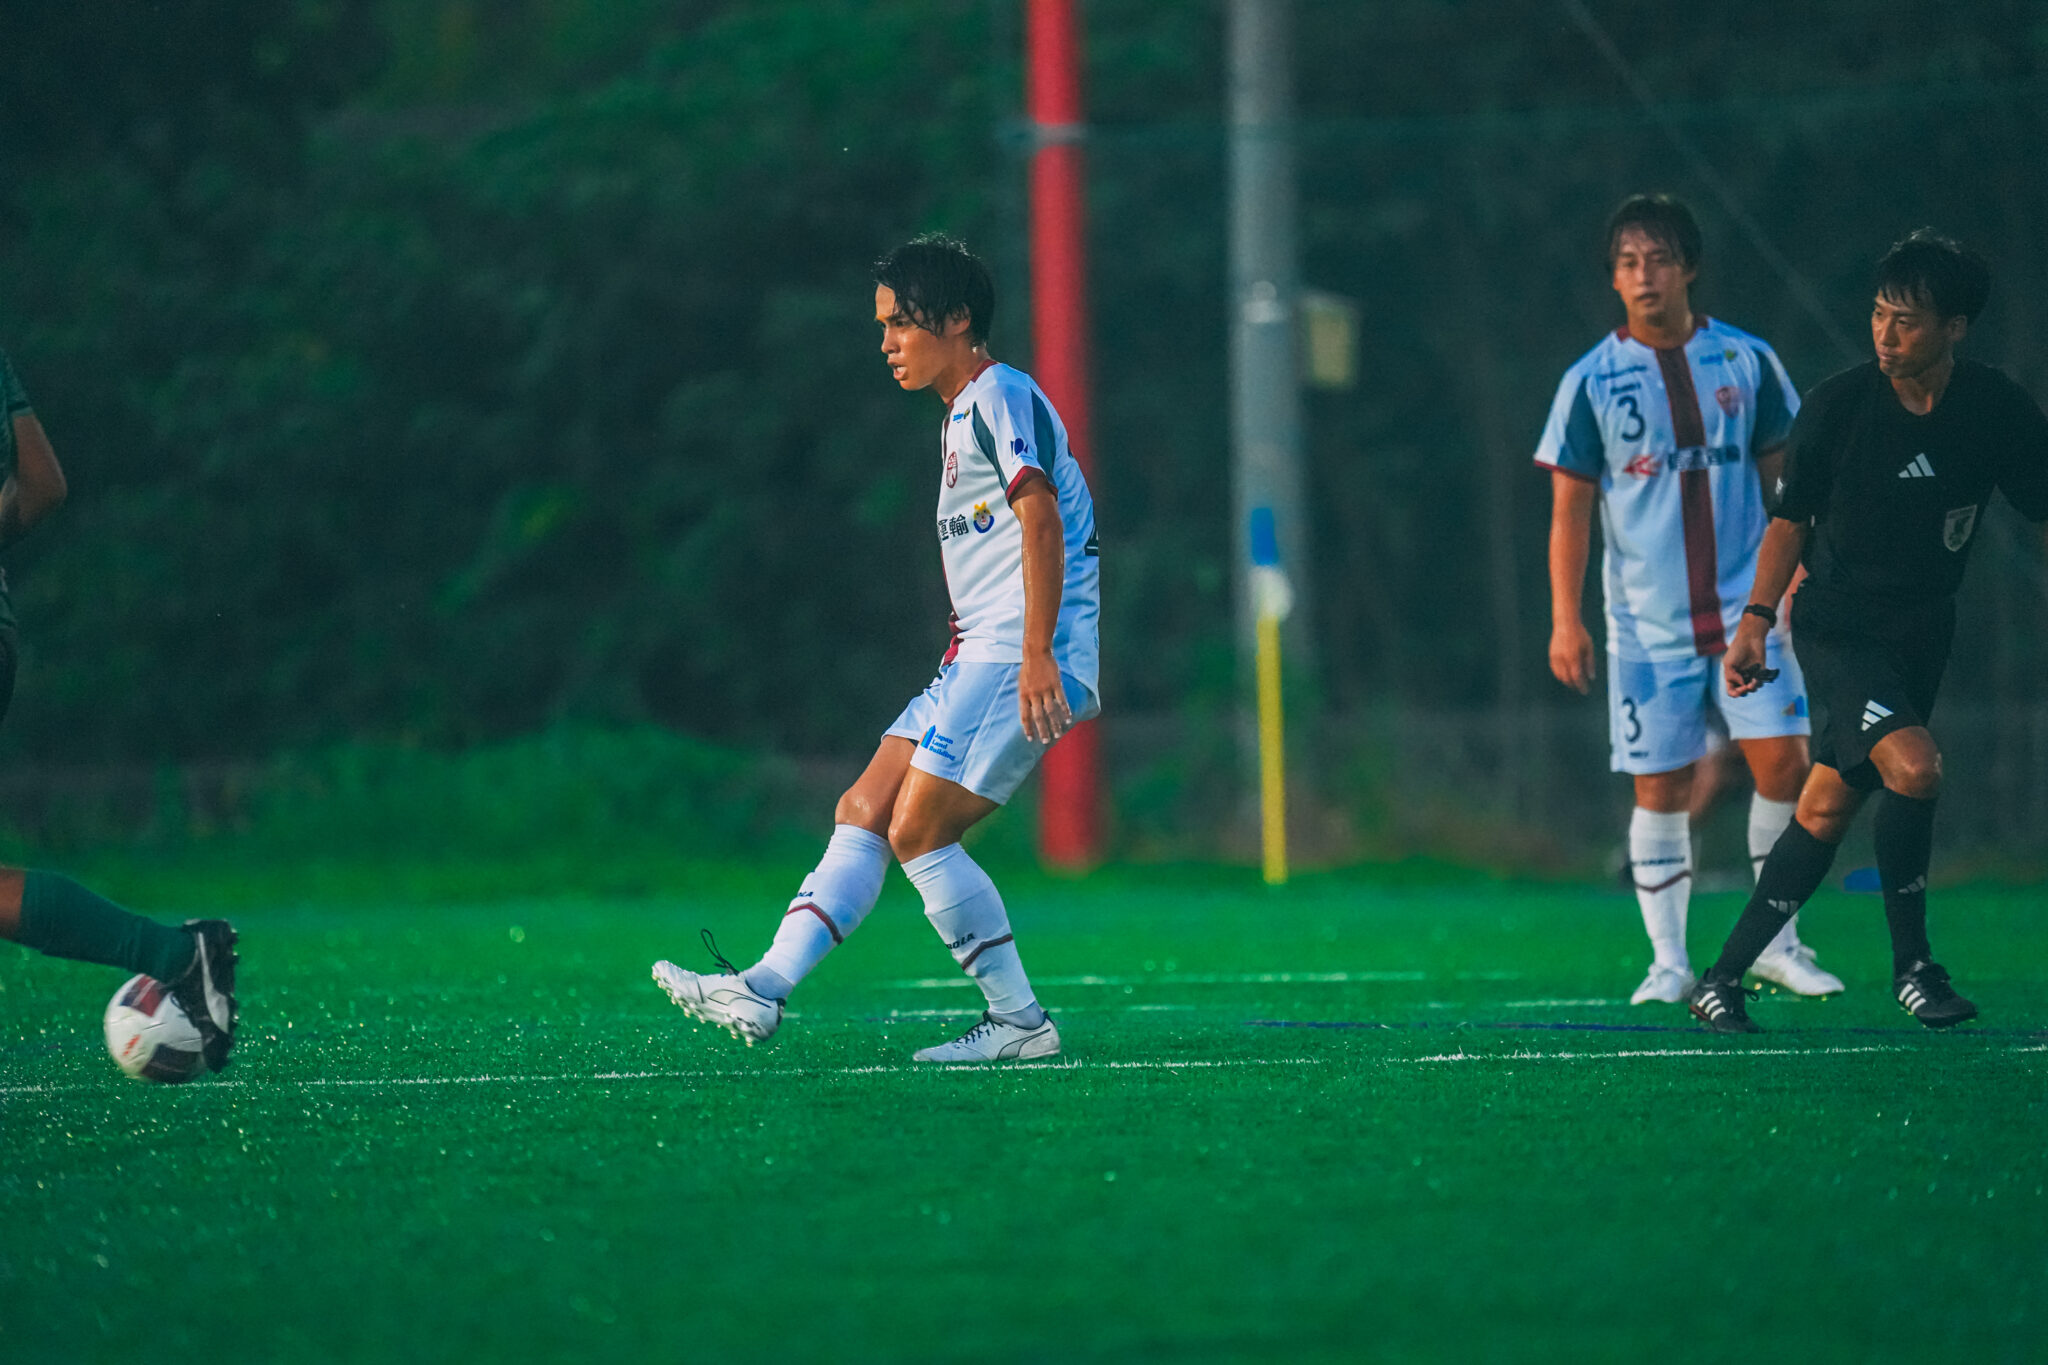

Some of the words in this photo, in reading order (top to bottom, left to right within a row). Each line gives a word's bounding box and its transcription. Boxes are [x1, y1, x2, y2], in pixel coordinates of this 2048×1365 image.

[1617, 395, 1645, 442] 3
[935, 733, 954, 744] Japan
[1622, 697, 1642, 743] 3
